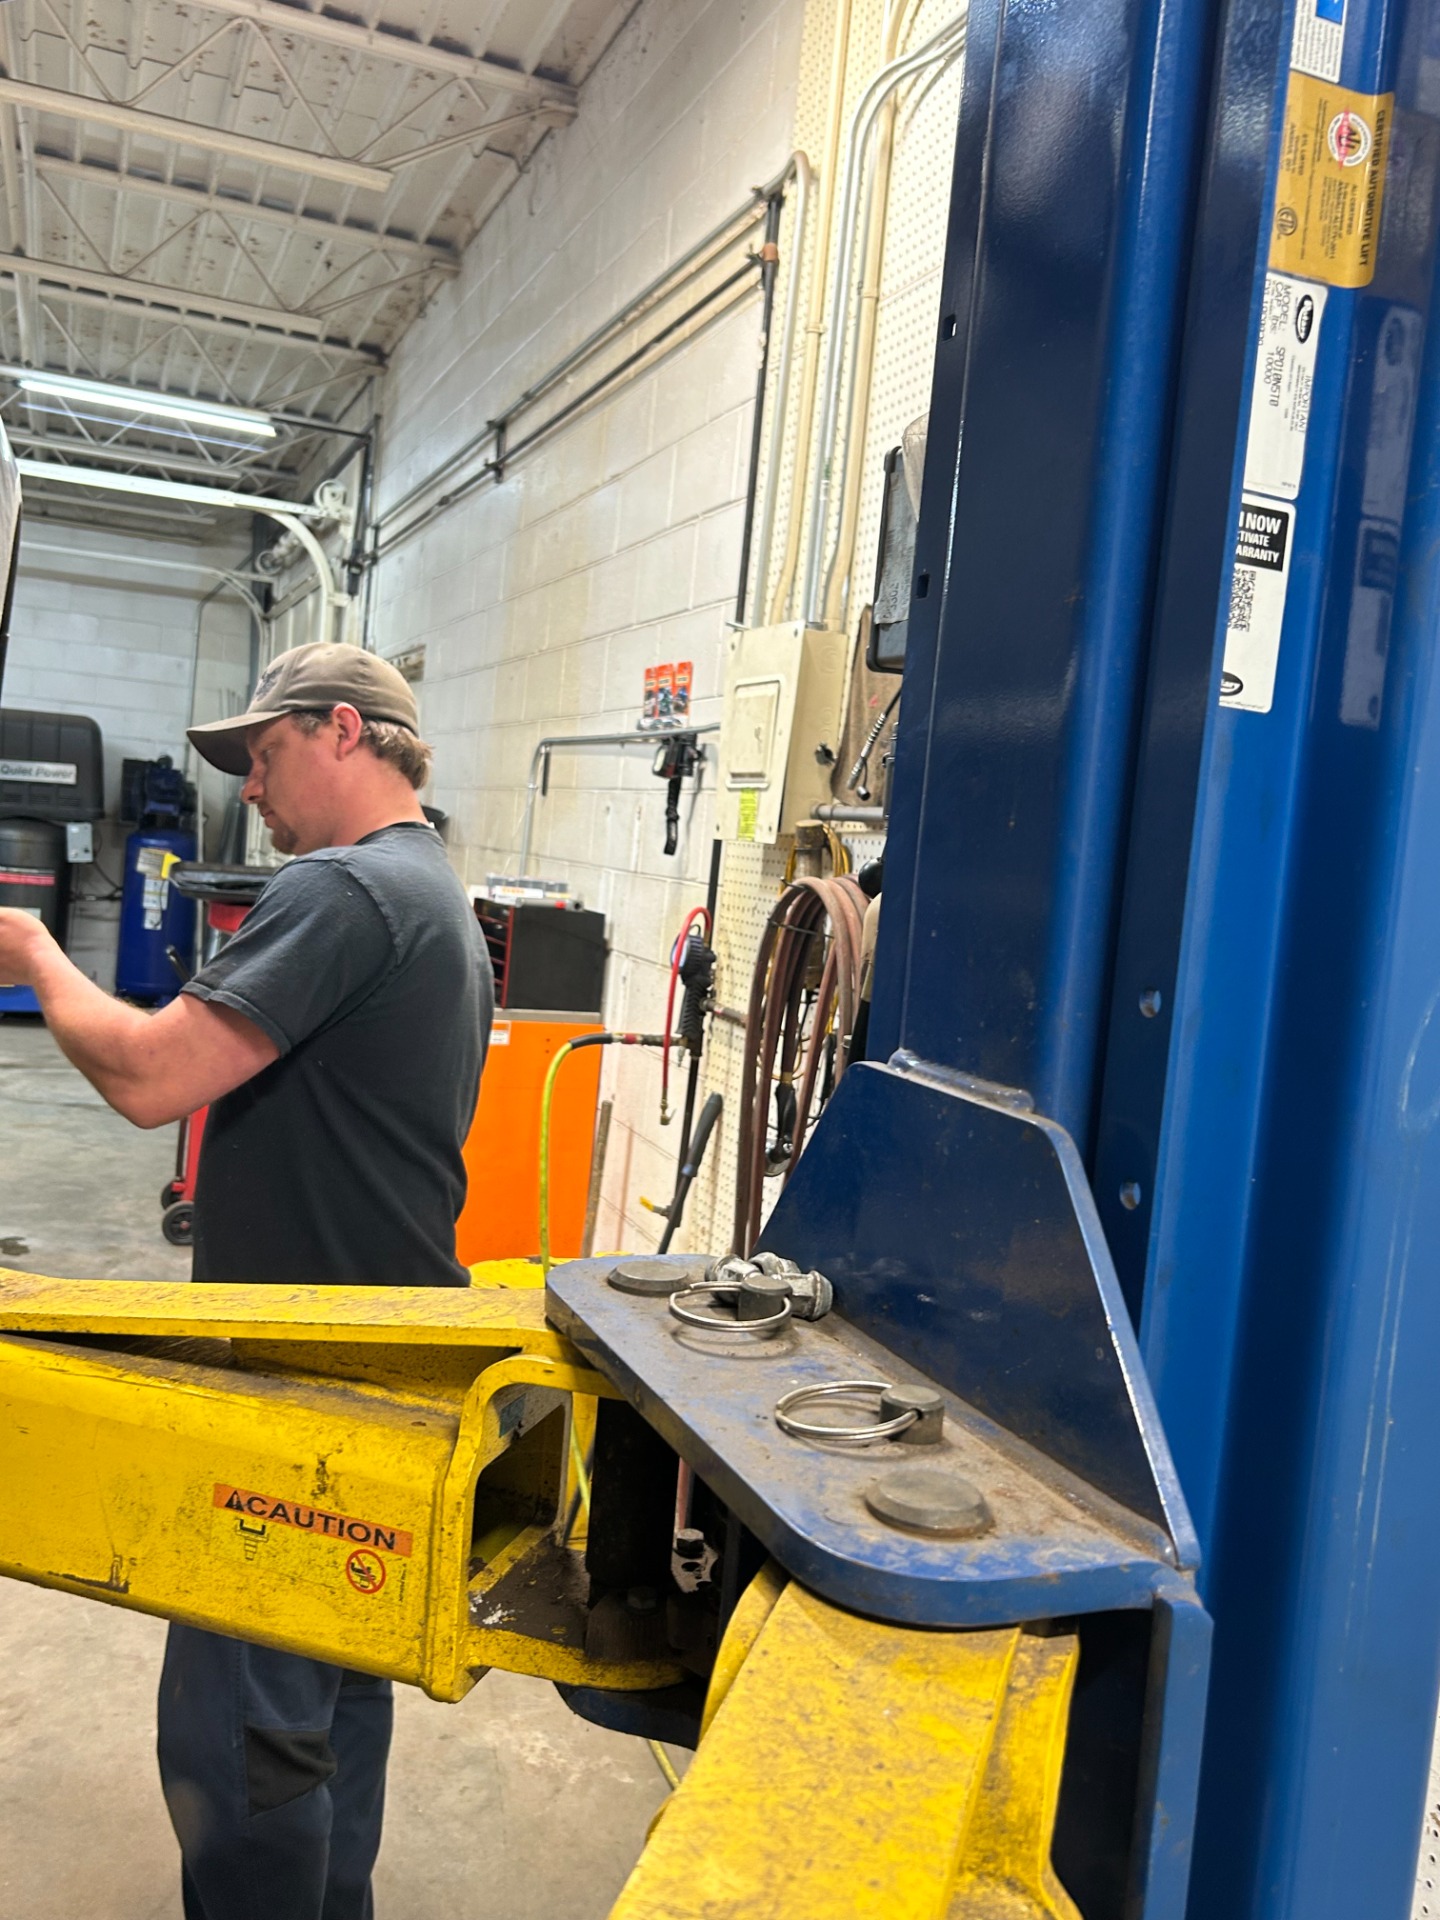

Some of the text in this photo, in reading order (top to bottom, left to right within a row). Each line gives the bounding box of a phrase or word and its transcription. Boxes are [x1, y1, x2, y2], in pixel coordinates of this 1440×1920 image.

[1359, 110, 1385, 266] CERTIFIED AUTOMOTIVE LIFT
[1279, 284, 1291, 331] MODEL:
[1264, 351, 1274, 384] 10000
[1245, 512, 1281, 535] NOW
[1239, 531, 1270, 547] TIVATE
[1235, 544, 1279, 563] ARRANTY
[1, 763, 33, 776] Quiet
[247, 1496, 396, 1550] CAUTION
